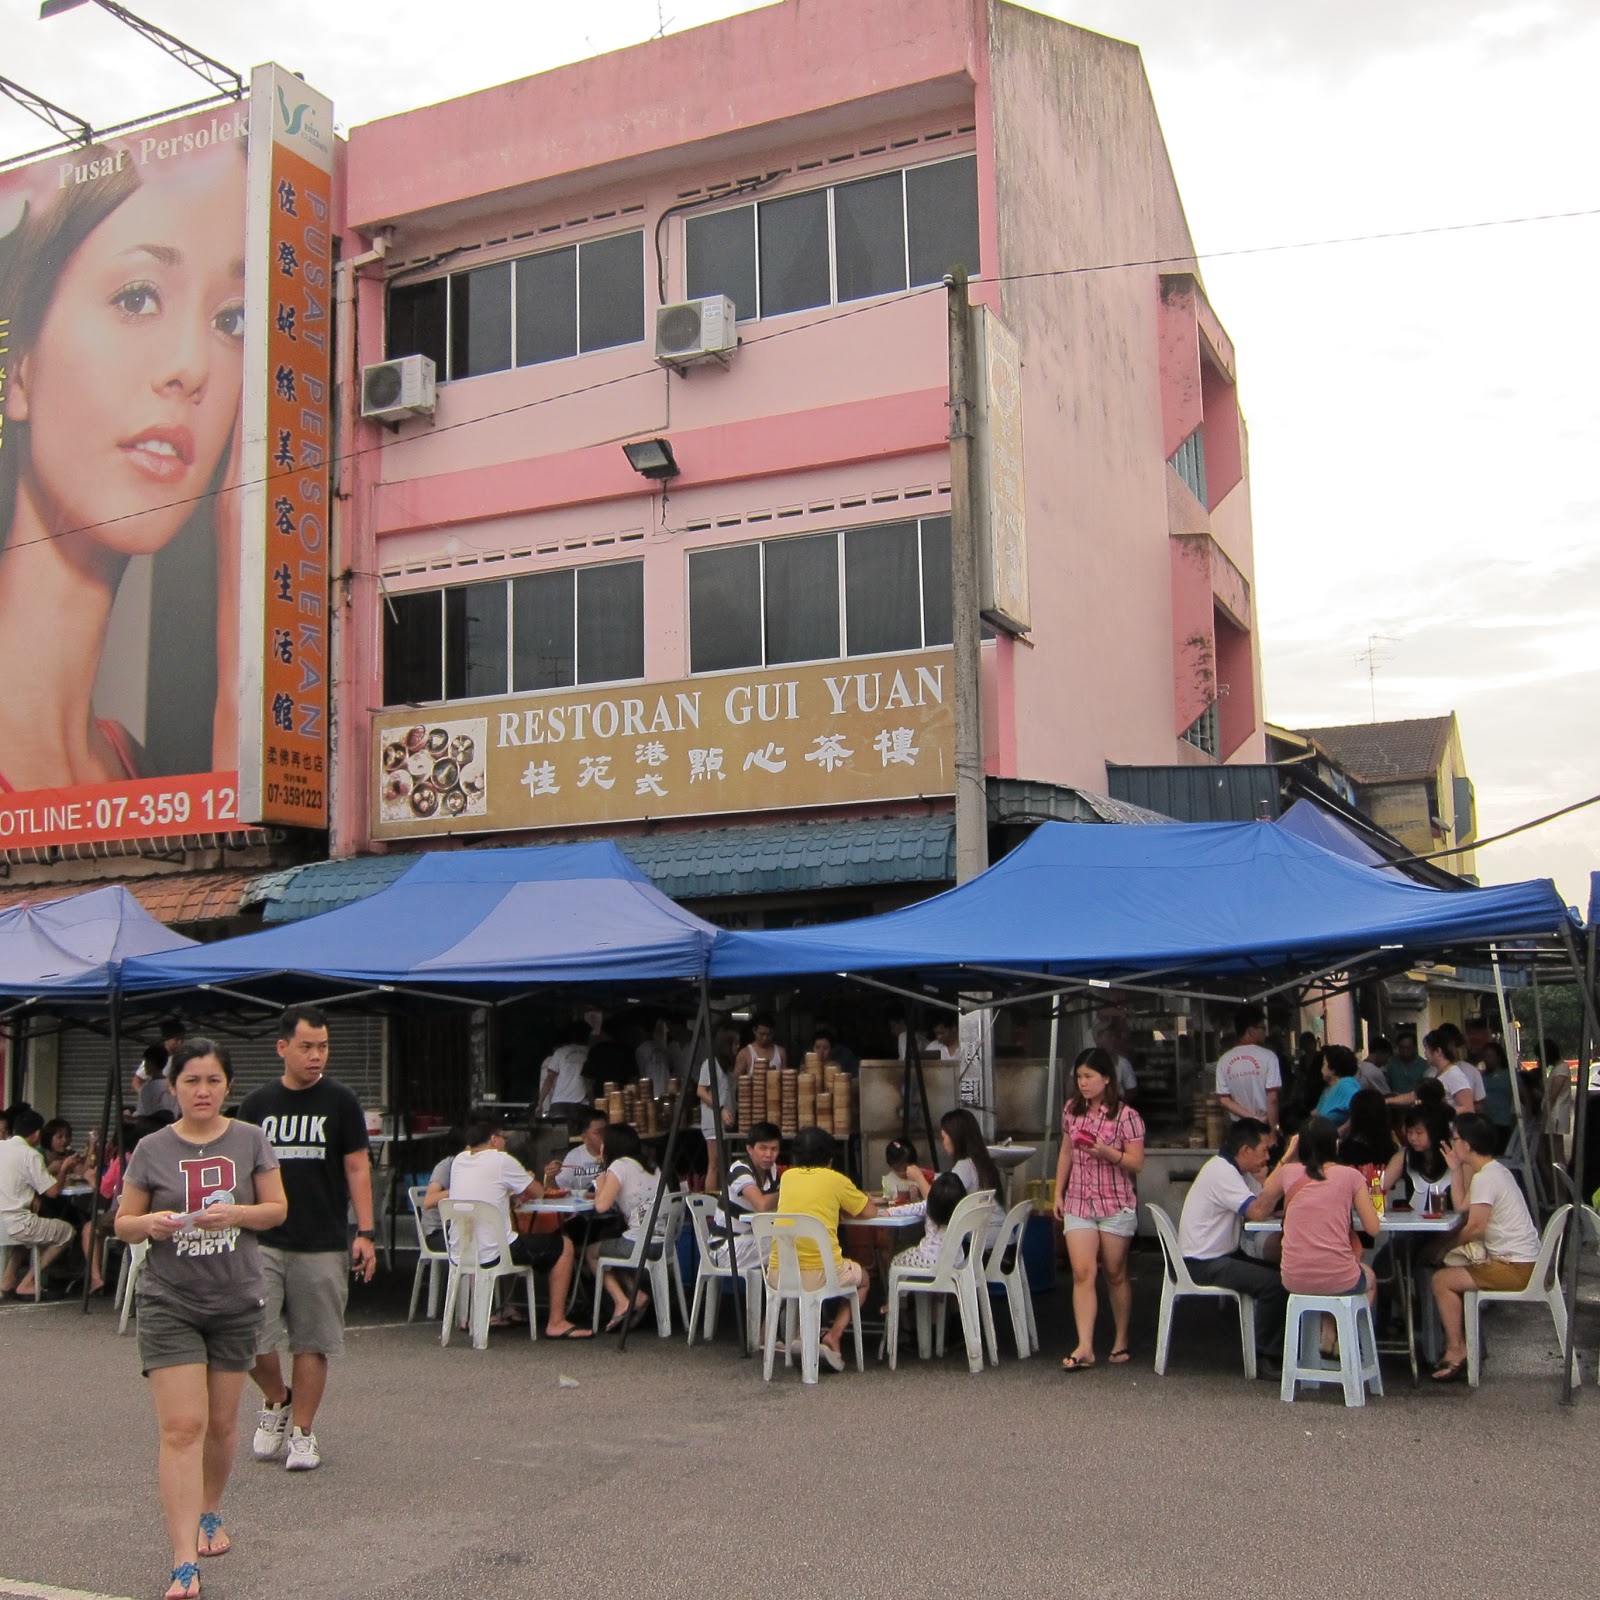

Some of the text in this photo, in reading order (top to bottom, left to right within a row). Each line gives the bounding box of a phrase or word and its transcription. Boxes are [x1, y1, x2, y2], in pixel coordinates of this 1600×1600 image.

[57, 149, 131, 190] Pusat
[139, 113, 250, 167] Persolek
[298, 190, 329, 740] PUSAT PERSOLEKAN
[496, 664, 945, 748] RESTORAN GUI YUAN
[201, 787, 238, 821] 12
[267, 783, 323, 810] 07-3591223
[261, 1115, 328, 1143] QUIK
